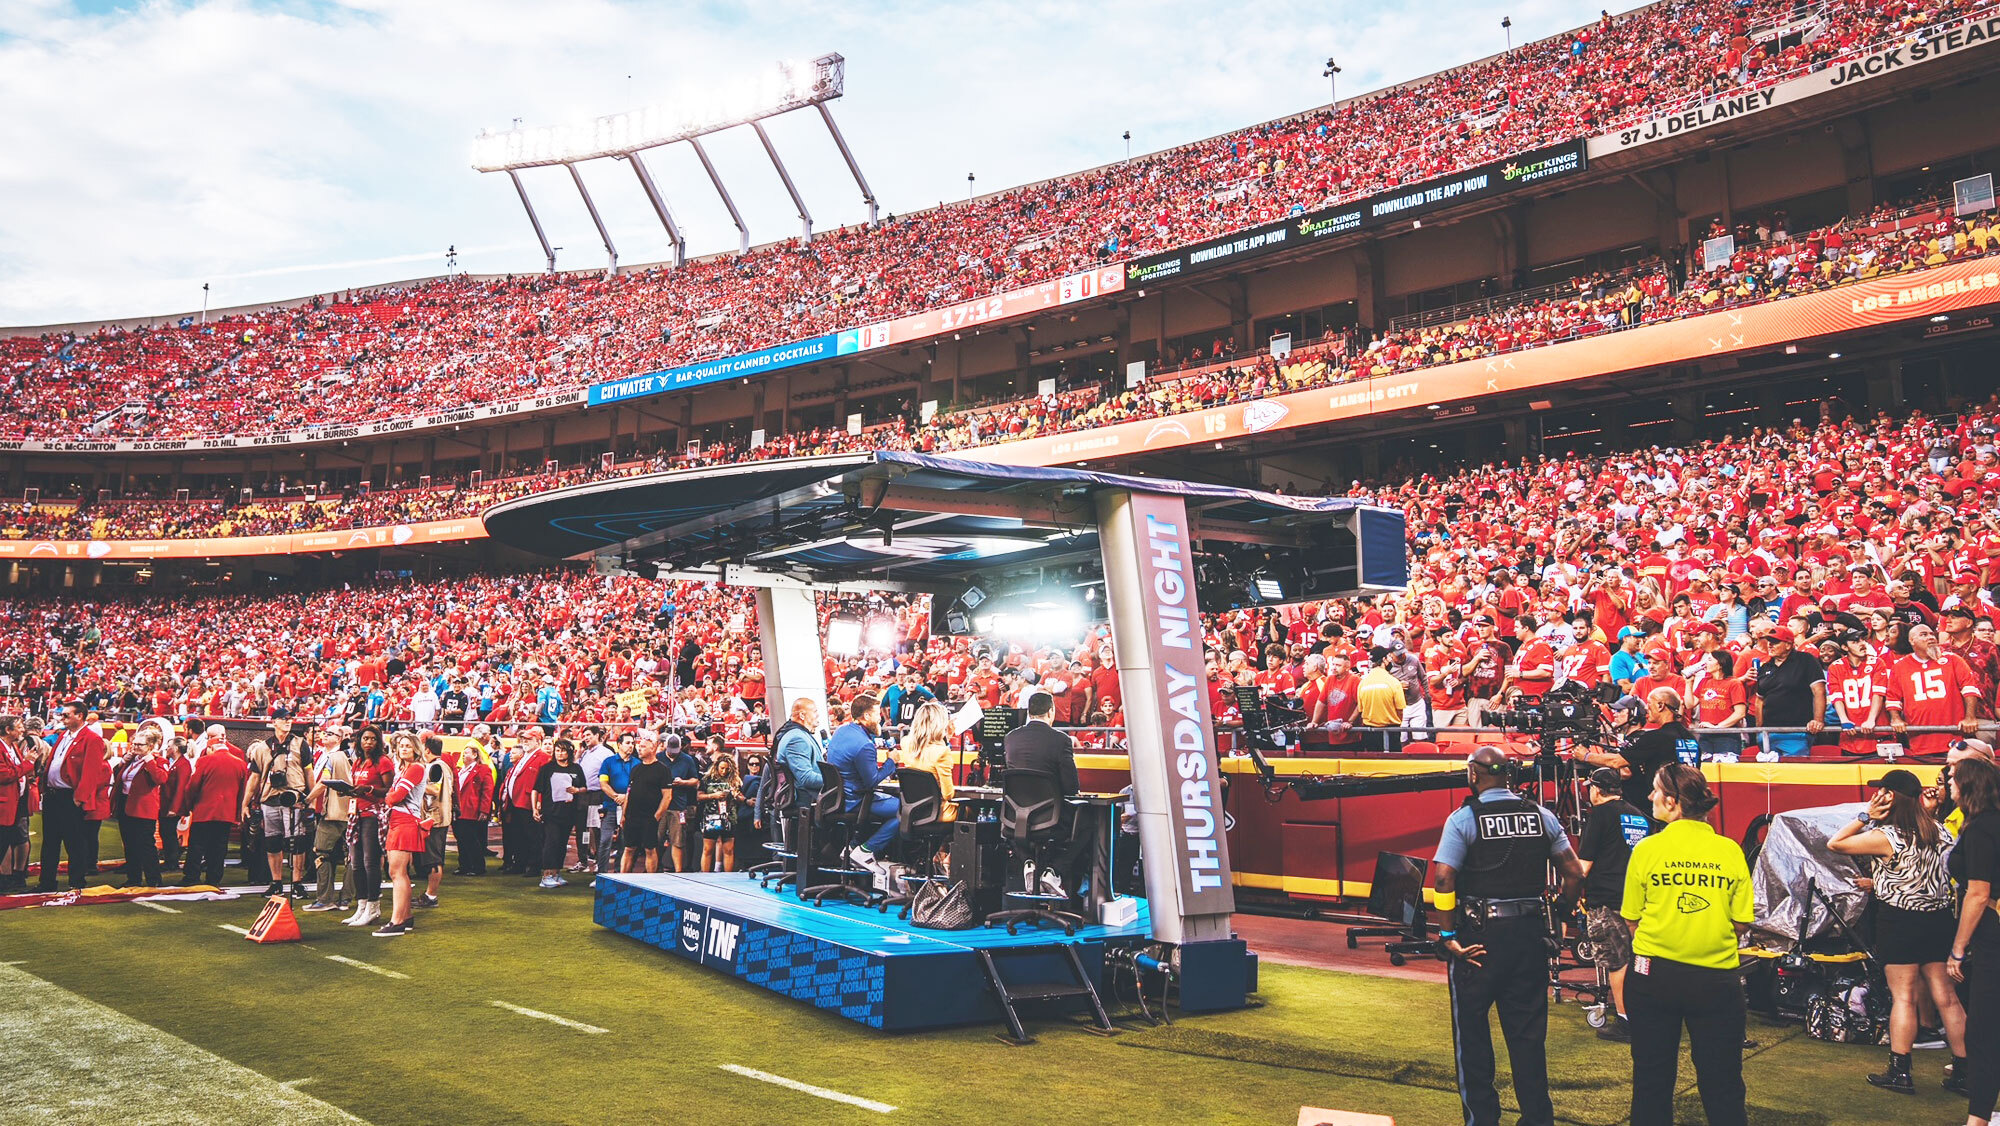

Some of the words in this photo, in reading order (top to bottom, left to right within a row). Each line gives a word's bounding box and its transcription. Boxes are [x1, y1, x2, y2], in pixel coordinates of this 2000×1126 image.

[1830, 50, 1903, 86] JACK
[1620, 129, 1640, 146] 37
[1644, 121, 1663, 141] J.
[1667, 88, 1776, 134] DELANEY
[1522, 161, 1578, 182] SPORTSBOOK
[1372, 192, 1424, 217] DOWNLOAD
[1425, 187, 1443, 203] THE
[1444, 181, 1463, 200] APP
[1464, 174, 1488, 193] NOW
[1314, 219, 1361, 237] SPORTSBOOK
[1190, 244, 1233, 264] DOWNLOAD
[1233, 240, 1248, 252] THE
[1249, 235, 1265, 250] APP
[1266, 228, 1287, 245] NOW
[1141, 267, 1181, 281] SPORTSBOOK
[1064, 289, 1072, 299] 3
[1852, 293, 1893, 313] LOS
[1897, 272, 2000, 305] ANGELES
[941, 299, 1003, 329] 17:12
[601, 377, 652, 400] CUTWATER
[676, 363, 733, 382] BAR-QUALITY
[734, 354, 770, 370] CANNED
[773, 343, 824, 363] COCKTAILS
[556, 393, 579, 404] SPANI
[1330, 388, 1385, 408] KANSAS
[1386, 383, 1420, 399] CITY
[442, 411, 475, 422] THOMAS
[506, 403, 520, 413] ALT
[323, 428, 359, 439] BURRUSS
[390, 420, 414, 431] OKOYE
[1204, 413, 1227, 434] VS
[220, 439, 238, 447] HILL
[270, 435, 291, 444] STILL
[1146, 513, 1194, 649] NIGHT
[1562, 654, 1587, 678] 87
[1843, 674, 1871, 709] 87
[1910, 668, 1947, 702] 15
[901, 703, 915, 720] 10
[1165, 663, 1223, 893] THURSDAY
[1484, 813, 1539, 837] POLICE
[1664, 861, 1722, 871] LANDMARK
[1651, 872, 1736, 891] SECURITY
[249, 901, 281, 937] 20
[683, 908, 701, 924] prime
[682, 923, 700, 941] video
[708, 917, 740, 962] TNF
[838, 956, 869, 970] THURSDAY
[844, 968, 863, 981] NIGHT
[840, 980, 869, 994] FOOTBALL
